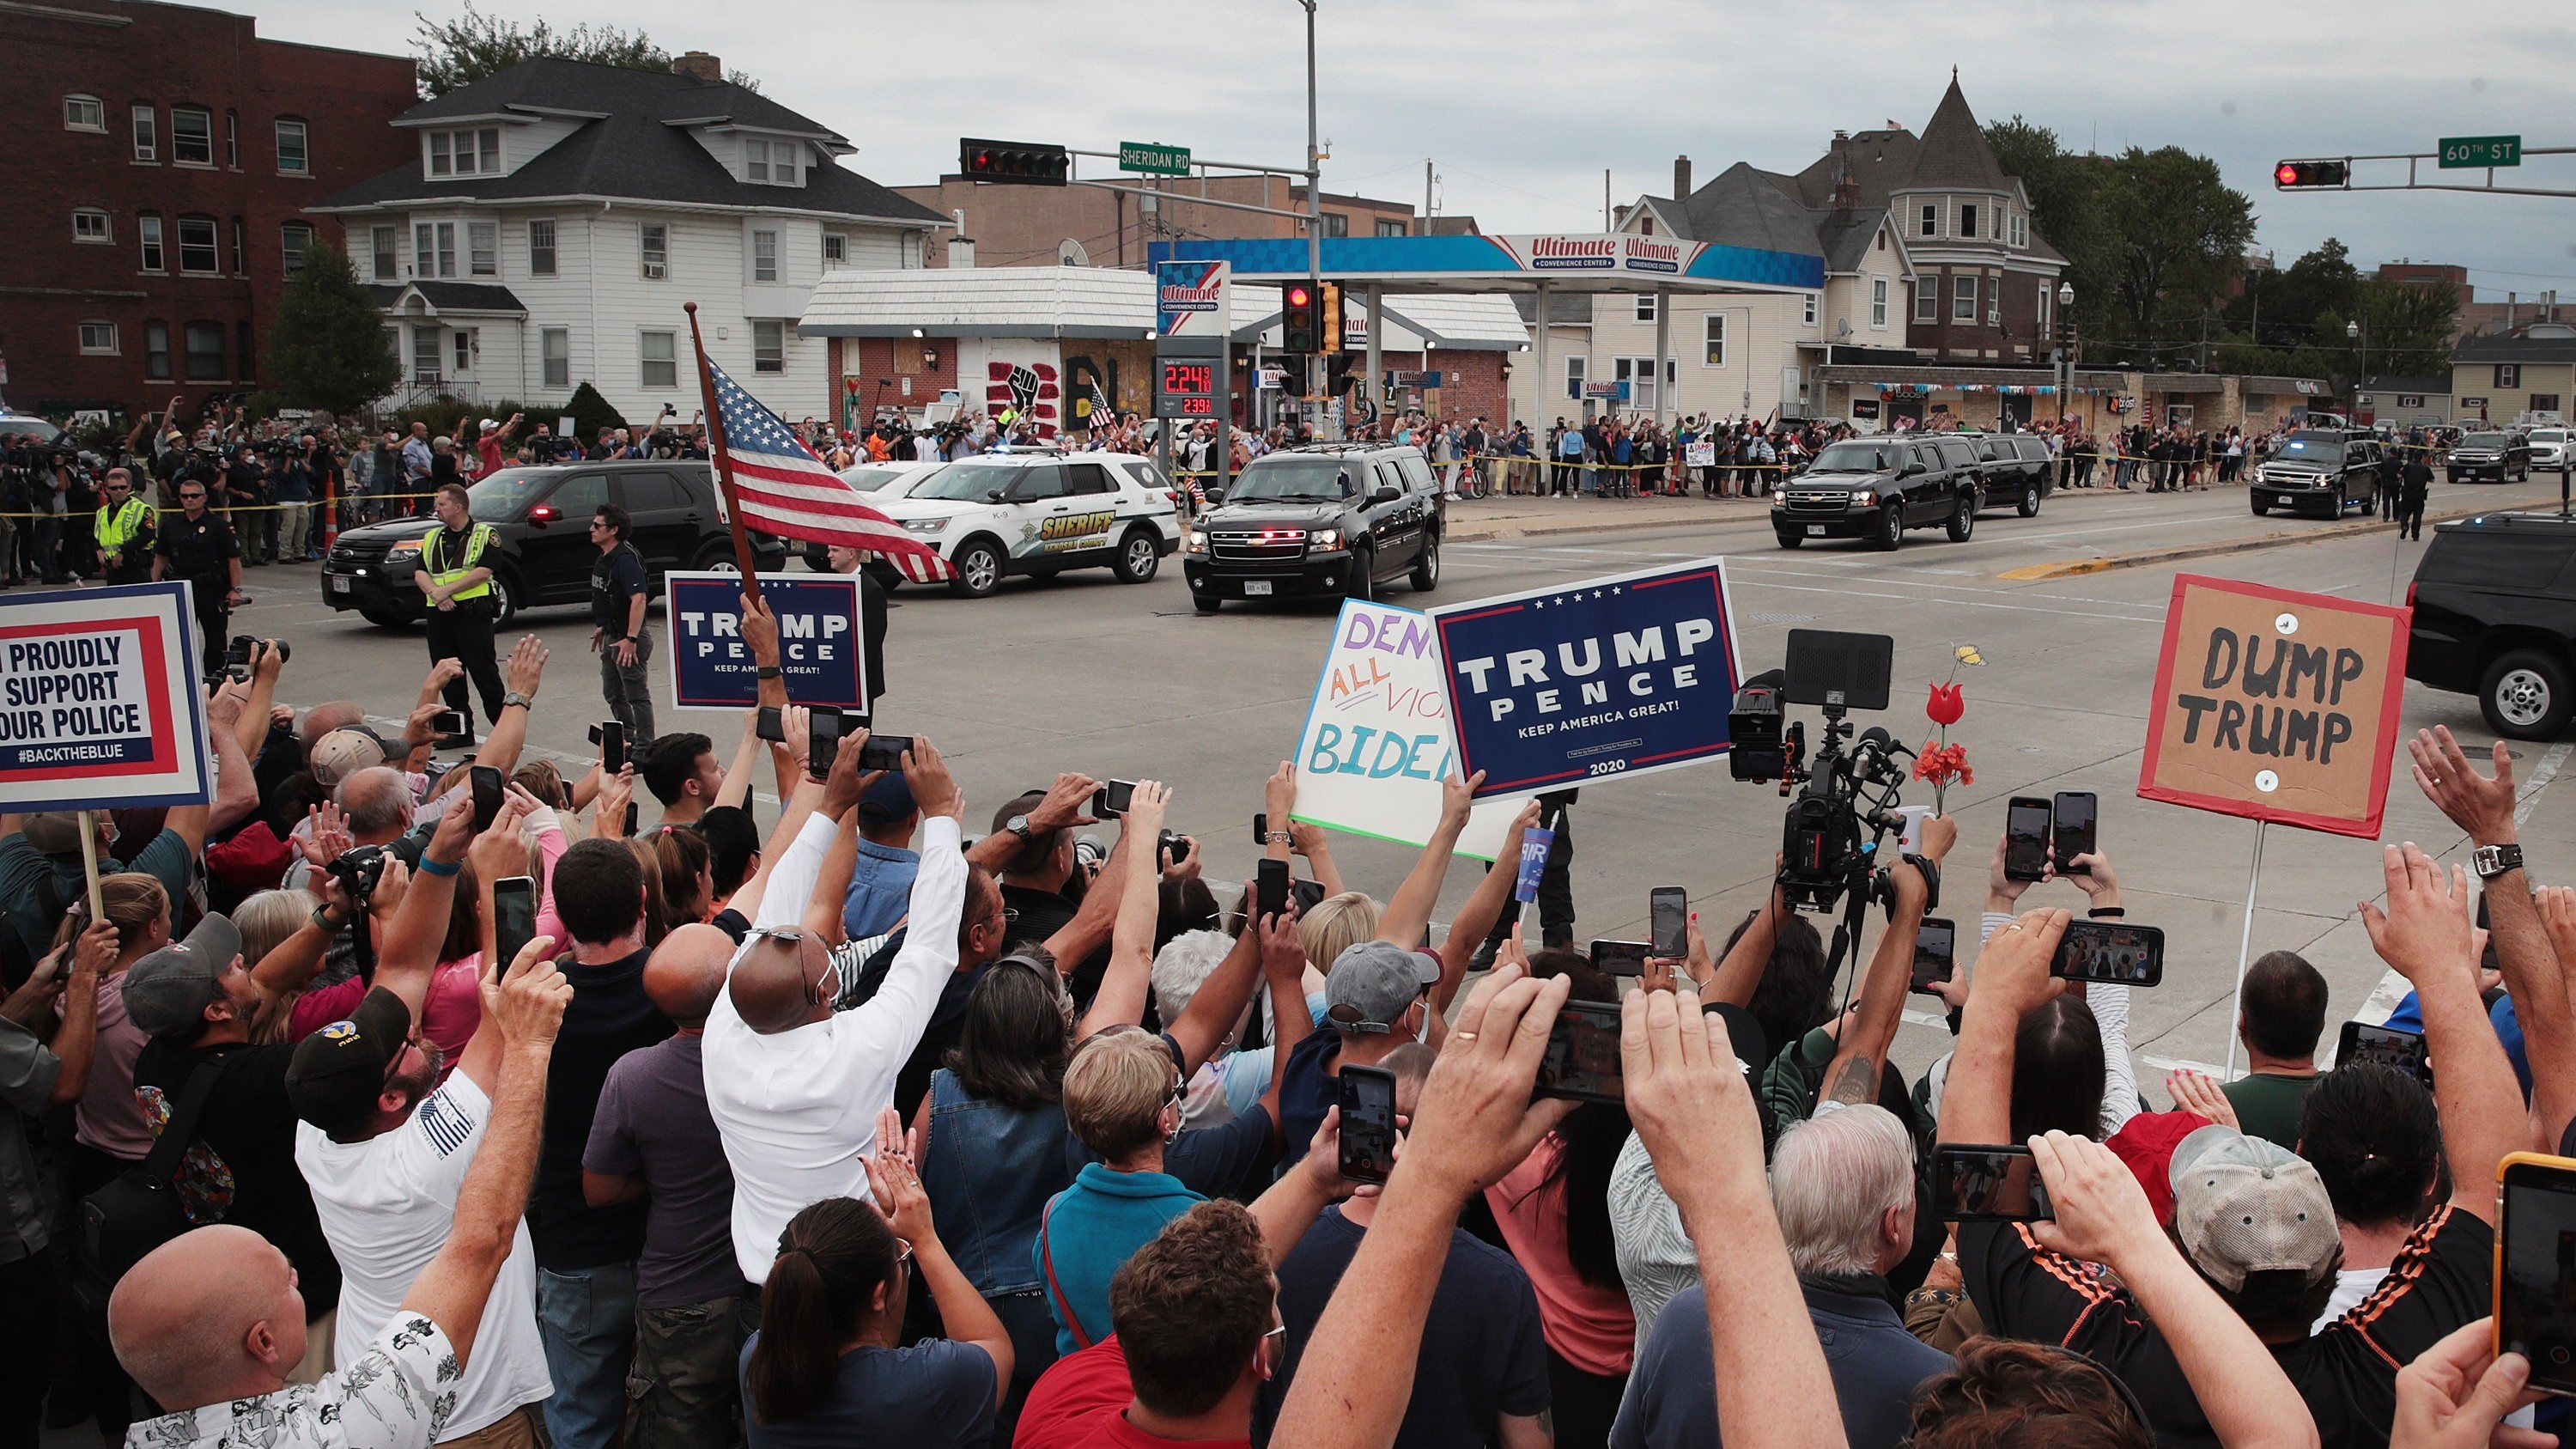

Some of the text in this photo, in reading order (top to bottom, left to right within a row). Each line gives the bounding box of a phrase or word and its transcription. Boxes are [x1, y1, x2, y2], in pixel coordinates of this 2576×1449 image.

[1121, 149, 1188, 169] SHERIDAN RD
[2491, 143, 2512, 159] ST
[1532, 236, 1616, 256] Ultimate
[1625, 238, 1679, 260] Ultimate
[1161, 285, 1219, 301] Ultimate
[1388, 387, 1393, 399] 7
[1040, 510, 1116, 541] SHERIFF
[1043, 537, 1108, 552] KENOSHA COUNTY
[680, 612, 848, 639] TRMP
[9, 636, 121, 673] PROUDLY
[698, 642, 834, 660] PECE
[1457, 618, 1714, 694] TRUMP
[1330, 656, 1391, 701] ALL
[2202, 627, 2364, 705] DUMP
[6, 671, 118, 706] SUPPORT
[1388, 683, 1445, 719] VIO
[1490, 664, 1698, 721] PENCE
[0, 703, 141, 740] OUR POLICE
[1518, 700, 1680, 739] KEEP AMERICA GREAT!
[2178, 693, 2352, 764] TRUMP
[18, 744, 124, 764] #BACKTHEBLUE
[1589, 758, 1626, 776] 2020
